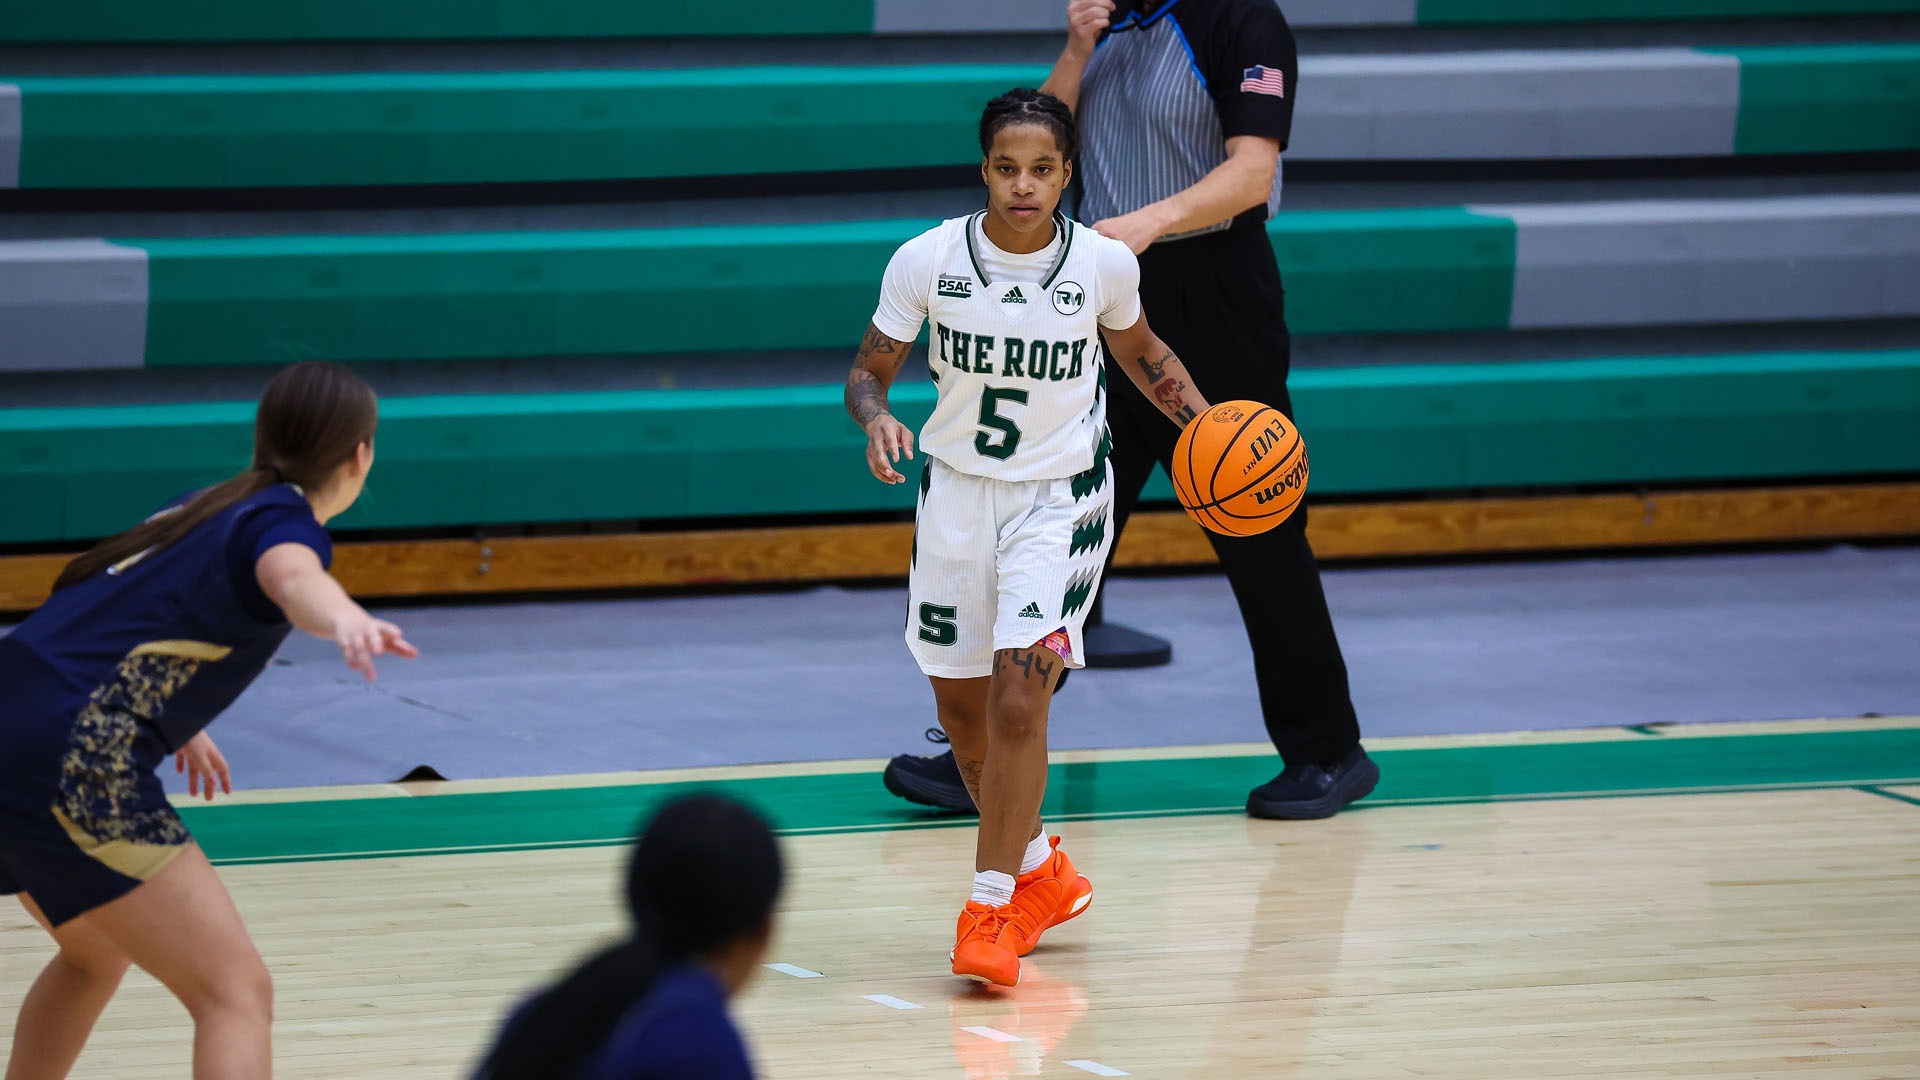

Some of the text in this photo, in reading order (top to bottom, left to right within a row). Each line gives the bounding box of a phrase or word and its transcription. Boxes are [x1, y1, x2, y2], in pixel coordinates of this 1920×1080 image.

[938, 279, 972, 293] PSAC
[1001, 296, 1027, 304] adidas
[936, 321, 1088, 382] THE ROCK
[973, 383, 1030, 463] 5
[1250, 418, 1287, 462] EVO
[1242, 458, 1257, 477] NXT
[918, 601, 958, 647] S
[1018, 610, 1044, 619] adidas
